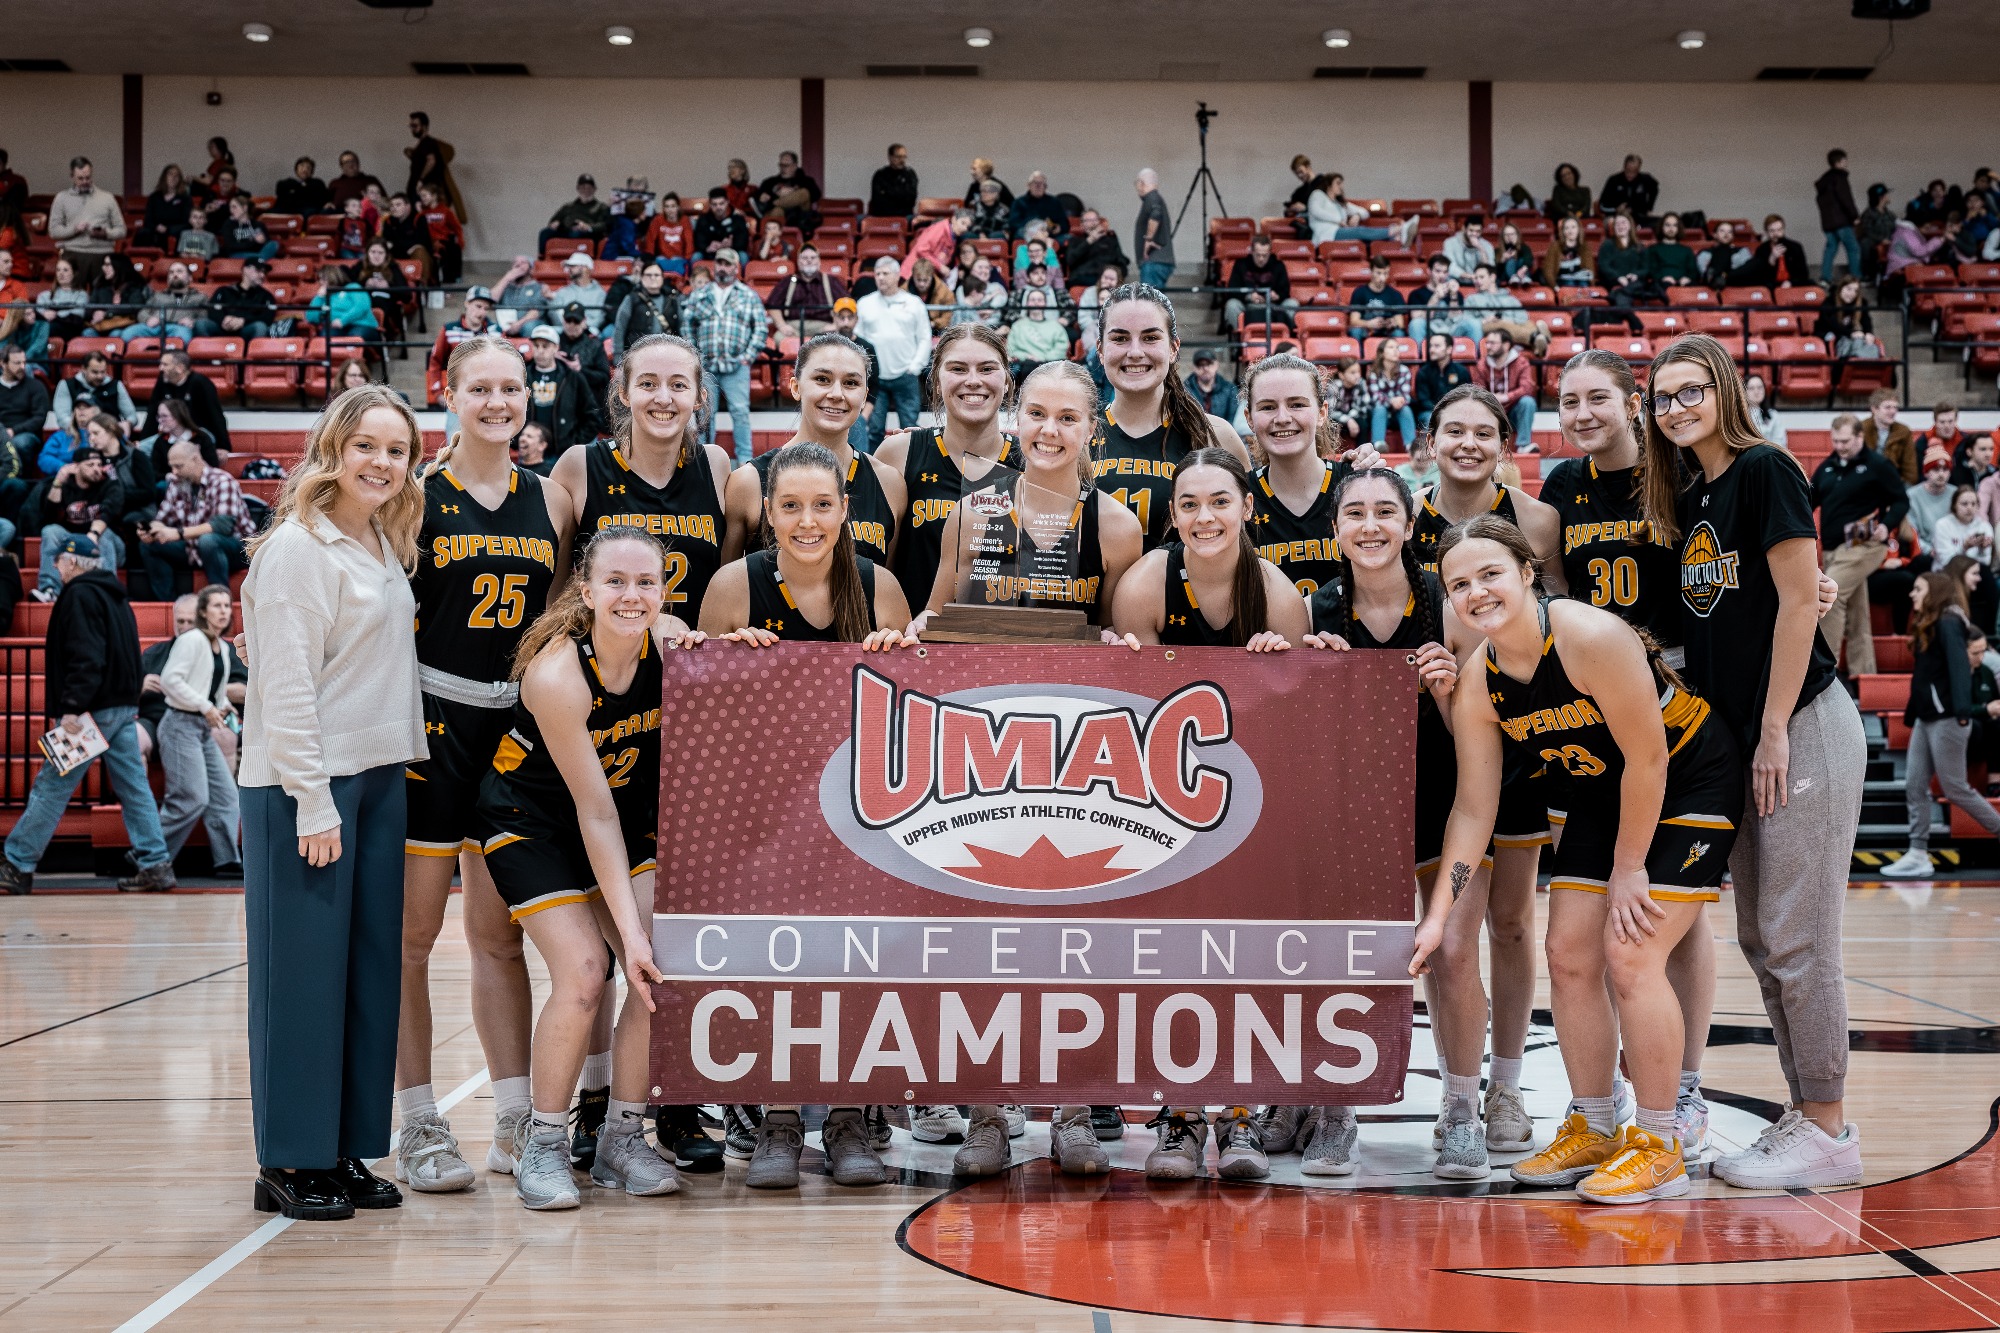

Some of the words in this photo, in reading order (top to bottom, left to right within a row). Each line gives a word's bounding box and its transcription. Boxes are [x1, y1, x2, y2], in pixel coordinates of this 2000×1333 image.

[972, 522, 1004, 531] 2023-24
[972, 536, 1003, 544] Women's
[433, 534, 554, 574] SUPERIOR
[970, 544, 1005, 553] Basketball
[972, 558, 1000, 567] REGULAR
[973, 566, 998, 574] SEASON
[1588, 556, 1639, 607] 30
[467, 573, 530, 628] 25
[850, 662, 1233, 831] UMAC
[902, 820, 949, 846] UPPER
[950, 806, 1016, 829] MIDWEST
[1020, 805, 1087, 820] ATHLETIC
[1089, 810, 1178, 850] CONFERENCE
[695, 924, 1378, 976] CONFERENCE
[689, 990, 1380, 1086] CHAMPIONS
